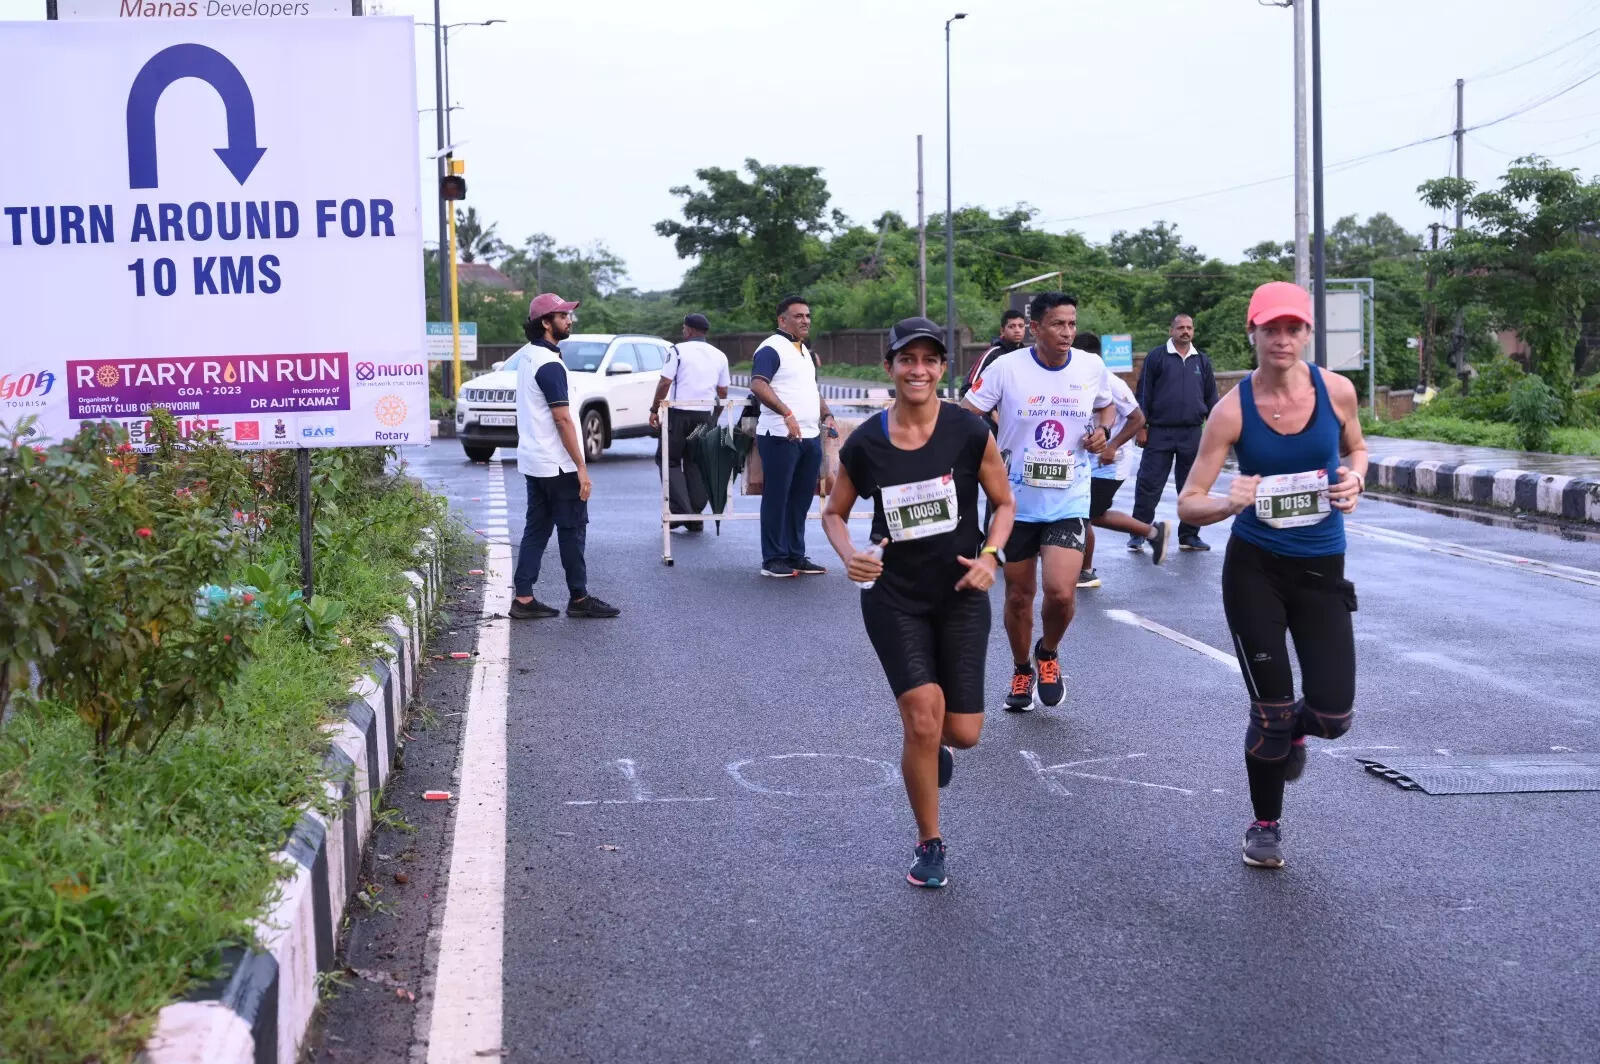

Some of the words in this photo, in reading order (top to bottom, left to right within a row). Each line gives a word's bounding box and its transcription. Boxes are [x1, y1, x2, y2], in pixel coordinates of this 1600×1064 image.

[119, 0, 198, 17] Manas
[206, 0, 310, 17] Developers
[4, 204, 115, 246] TURN
[130, 200, 299, 243] AROUND
[316, 198, 396, 239] FOR
[128, 257, 177, 297] 10
[193, 254, 282, 296] KMS
[276, 358, 340, 382] RUN
[378, 364, 424, 376] nuron
[178, 388, 203, 396] GOA
[213, 386, 242, 395] 2023
[78, 396, 109, 404] Organised
[250, 398, 268, 408] DR
[270, 397, 295, 408] AJIT
[298, 396, 340, 407] KAMAT
[78, 404, 113, 414] ROTARY
[115, 403, 138, 413] CLUB
[1070, 410, 1087, 418] RUN
[303, 428, 335, 437] GAR
[375, 431, 409, 441] Rotary
[1024, 463, 1033, 473] 10
[1038, 465, 1062, 476] 10151
[1257, 499, 1270, 511] 10
[1278, 494, 1312, 511] 10153
[886, 510, 899, 523] 10
